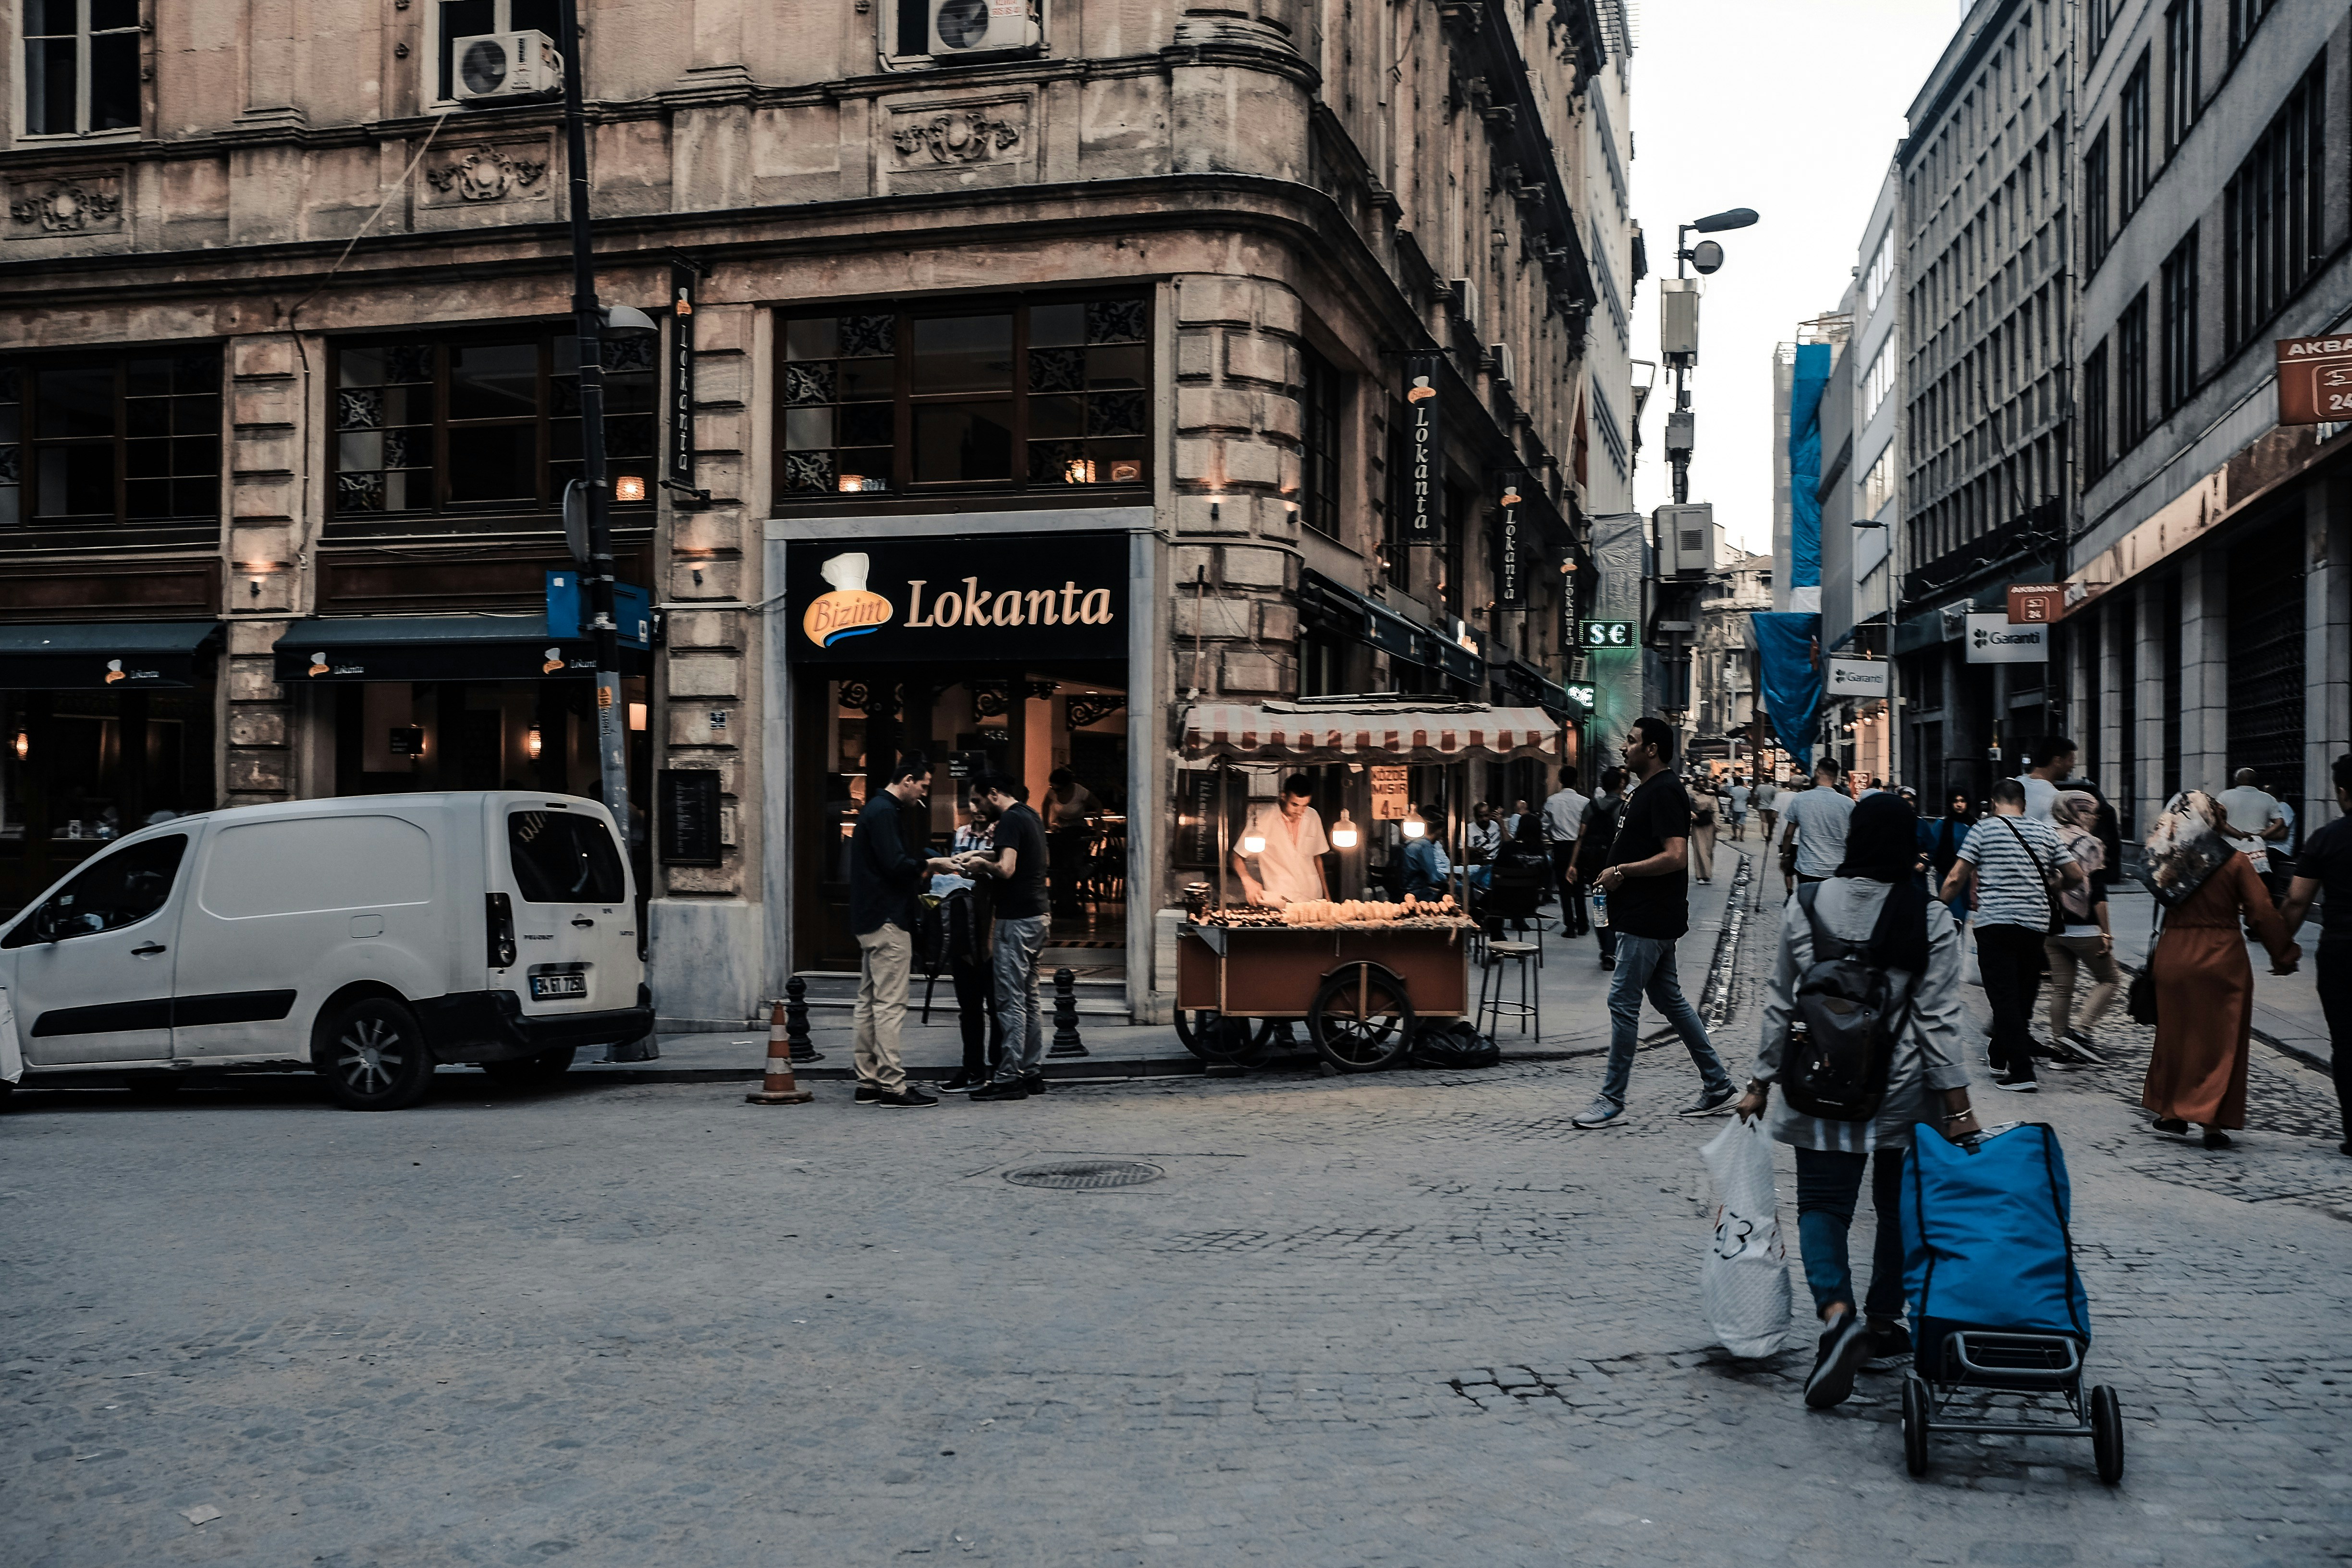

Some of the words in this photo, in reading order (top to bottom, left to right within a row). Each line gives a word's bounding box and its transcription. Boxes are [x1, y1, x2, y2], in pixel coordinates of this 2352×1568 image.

[678, 324, 688, 470] Lokanta
[1414, 407, 1429, 529] Lokanta
[1504, 509, 1517, 600] Lokanta
[813, 597, 882, 633] Bizim
[903, 576, 1114, 628] Lokanta
[1565, 576, 1575, 646] Lokanta
[1989, 631, 2041, 644] Garanti
[1847, 672, 1884, 684] Garanti
